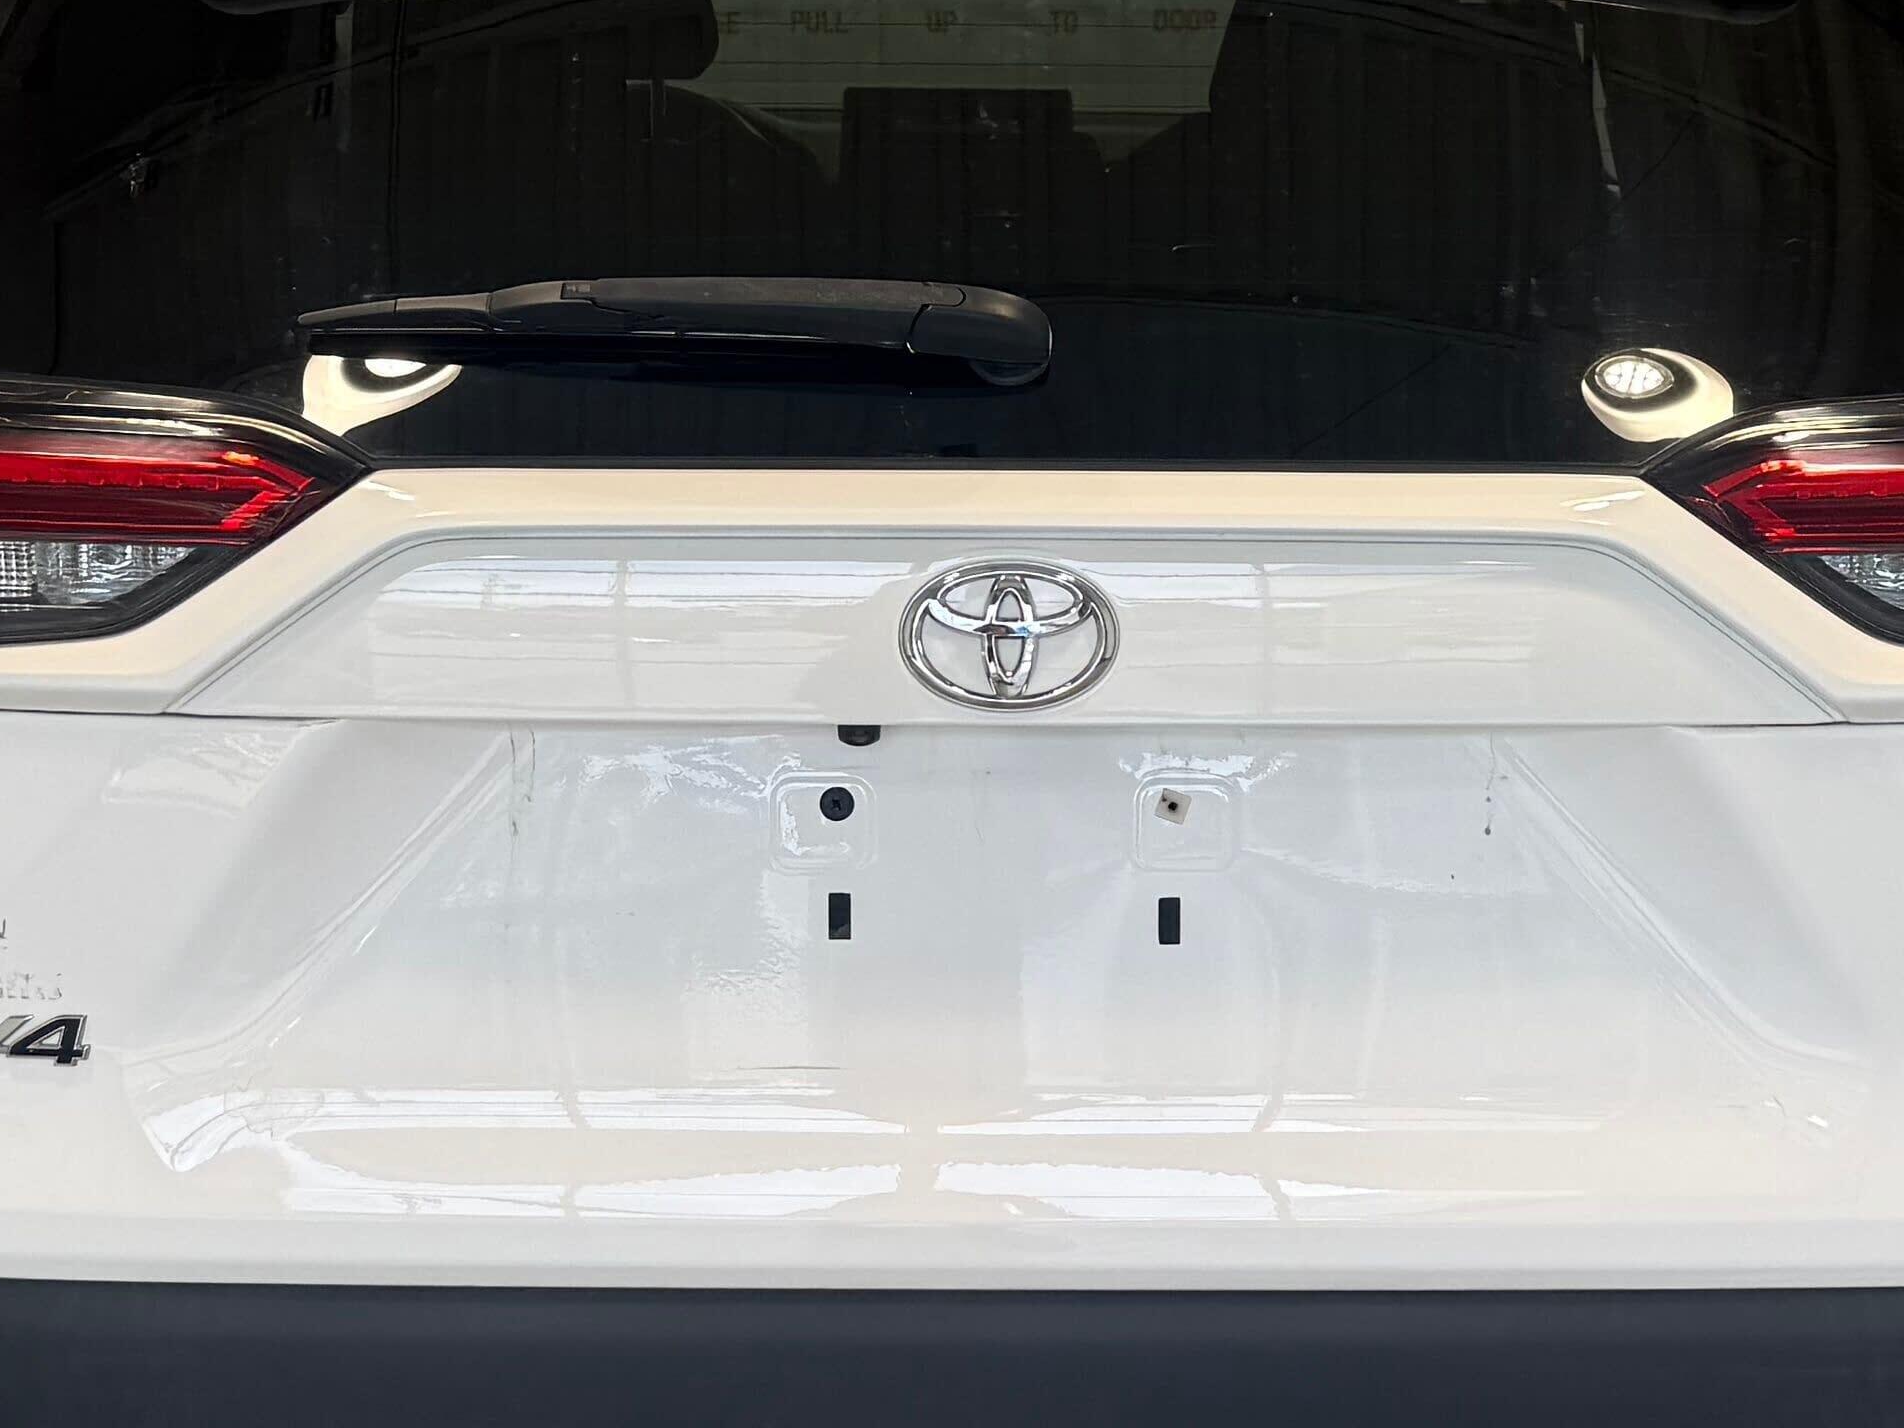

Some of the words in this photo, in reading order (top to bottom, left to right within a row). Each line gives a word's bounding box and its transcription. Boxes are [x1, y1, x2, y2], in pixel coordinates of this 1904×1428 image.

[791, 10, 848, 32] PULL
[927, 11, 958, 33] UP
[1050, 11, 1078, 34] TO
[1152, 9, 1217, 31] DOOR
